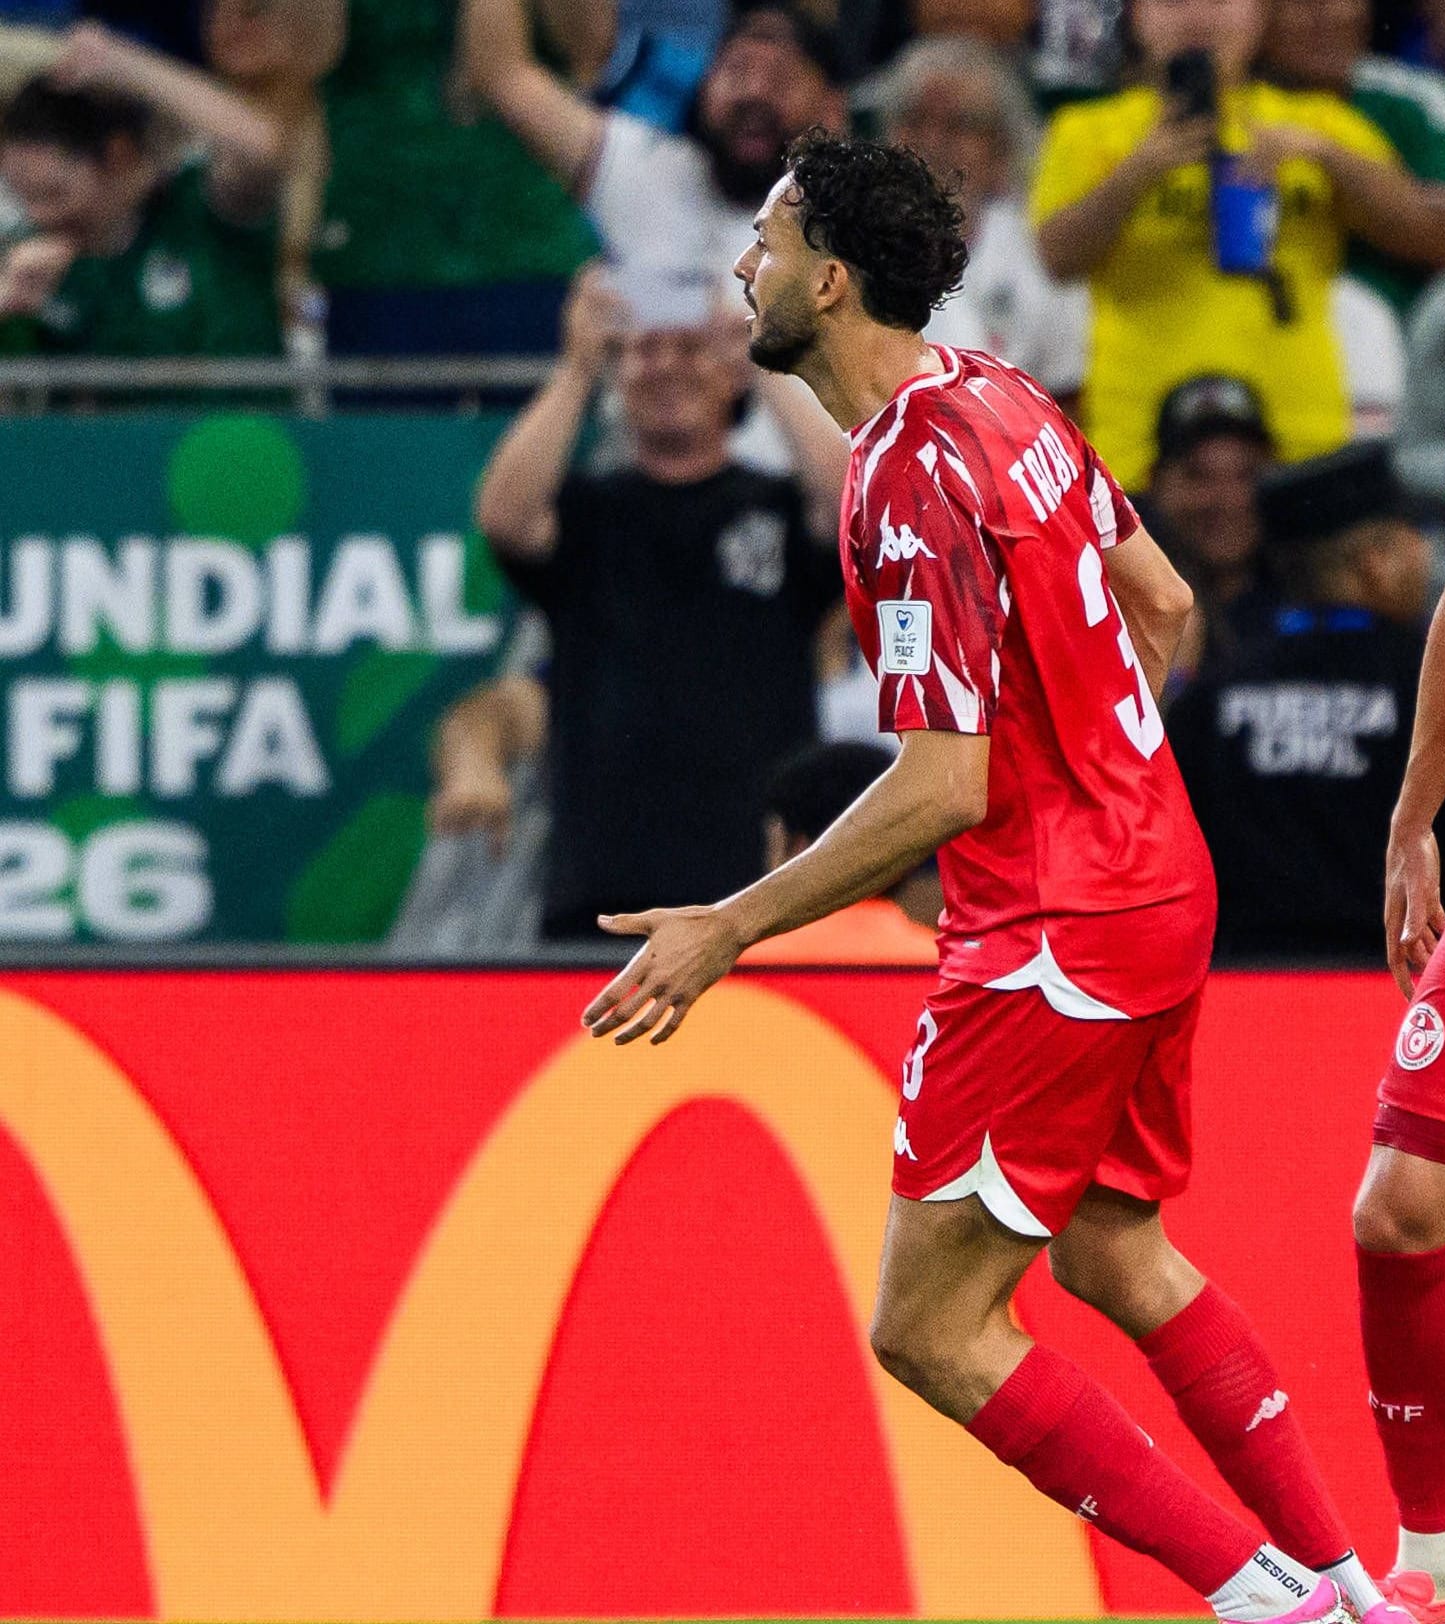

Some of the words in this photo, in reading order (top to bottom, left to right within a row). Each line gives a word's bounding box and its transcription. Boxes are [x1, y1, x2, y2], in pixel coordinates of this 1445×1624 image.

[1007, 421, 1079, 524] TALBI
[1076, 541, 1166, 762] 3
[5, 673, 332, 800] FIFA
[902, 1008, 938, 1101] 3
[1253, 1550, 1310, 1599] DESIGN
